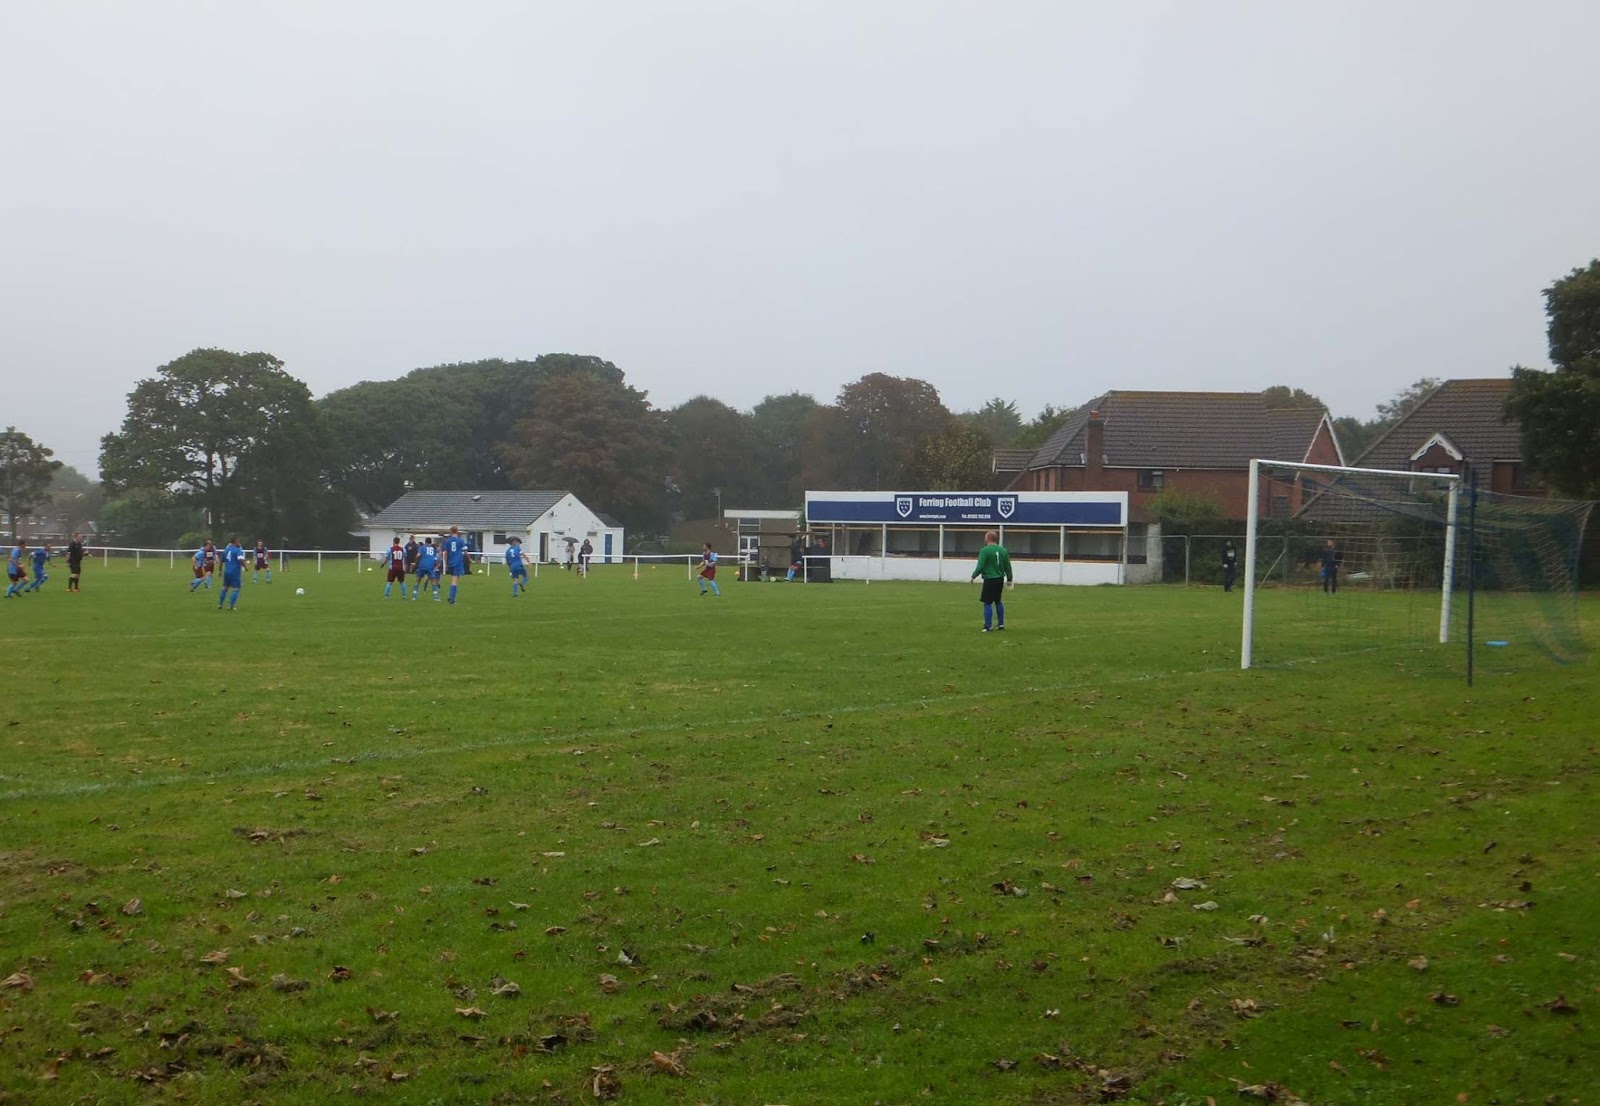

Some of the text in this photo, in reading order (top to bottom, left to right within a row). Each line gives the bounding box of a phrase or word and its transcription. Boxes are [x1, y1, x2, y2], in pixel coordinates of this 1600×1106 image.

[919, 498, 991, 508] Ferring Football Club
[226, 551, 231, 561] 4
[393, 551, 403, 560] 10
